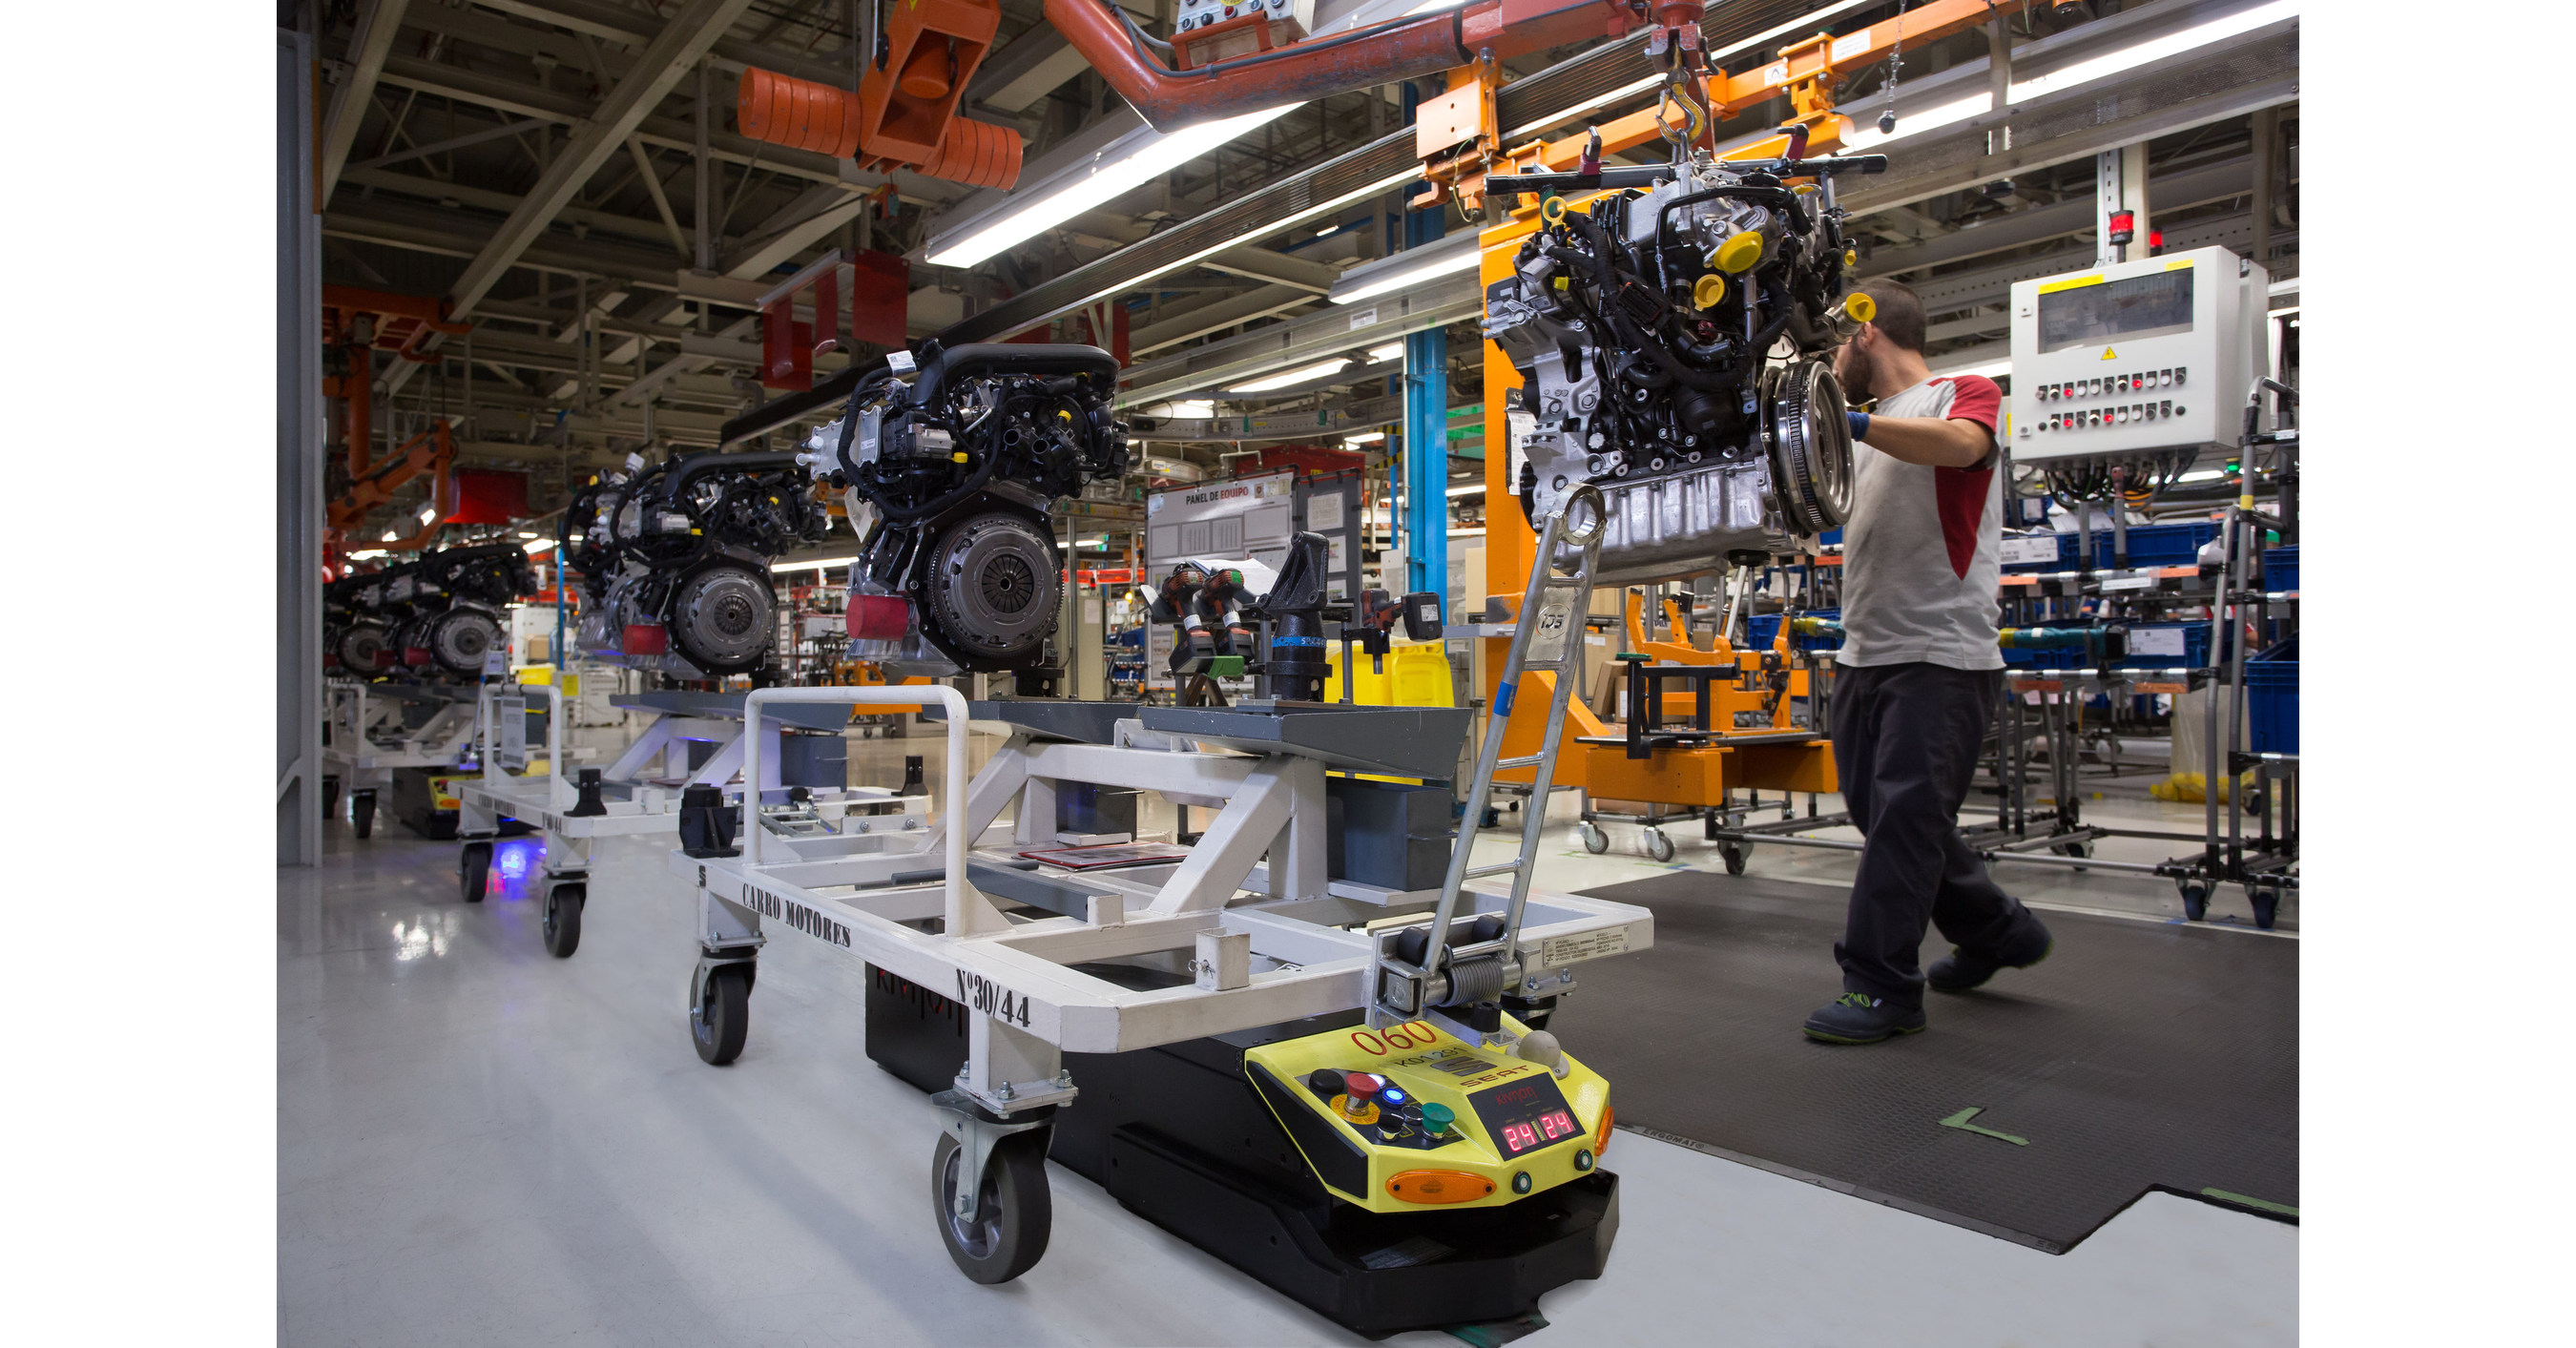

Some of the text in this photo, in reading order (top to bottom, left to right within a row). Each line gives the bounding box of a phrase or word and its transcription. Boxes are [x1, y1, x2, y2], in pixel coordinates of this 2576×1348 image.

[1186, 487, 1249, 506] PANEL DE EQUIPO
[742, 882, 851, 948] CARRO MOTORES
[1351, 1022, 1436, 1055] 060
[1460, 1065, 1529, 1088] SEAT
[1505, 1112, 1572, 1151] 24 24
